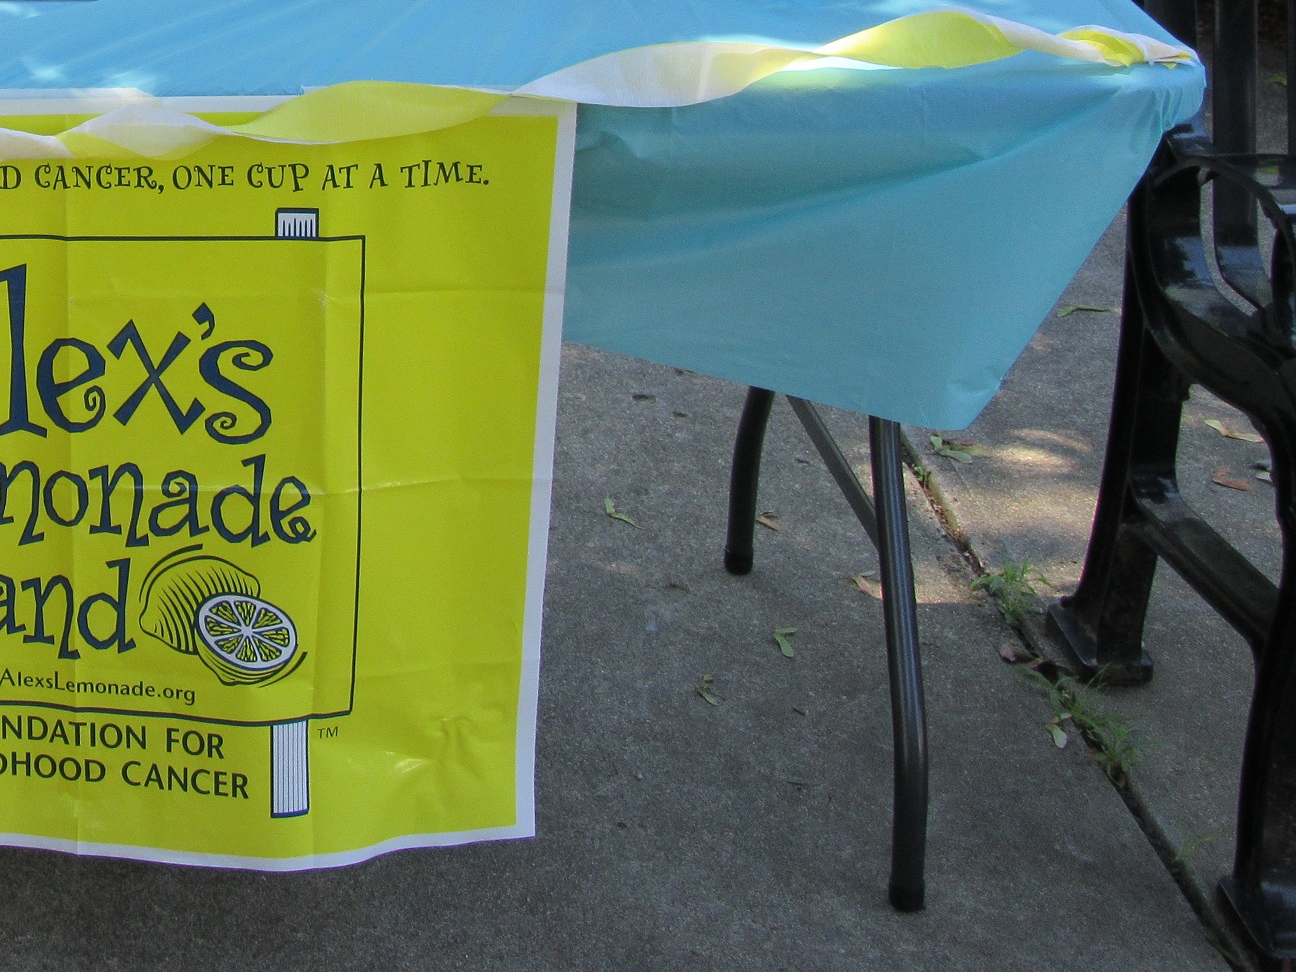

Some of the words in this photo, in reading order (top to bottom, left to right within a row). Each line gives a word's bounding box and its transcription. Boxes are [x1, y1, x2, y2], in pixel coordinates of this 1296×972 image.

[34, 162, 165, 195] CANCER,
[172, 164, 235, 190] ONE
[246, 162, 310, 193] CUP
[321, 163, 359, 191] AT
[369, 162, 389, 189] A
[400, 159, 490, 189] TIME.
[166, 727, 225, 760] FOR
[317, 726, 339, 740] TM
[120, 760, 250, 800] CANCER
